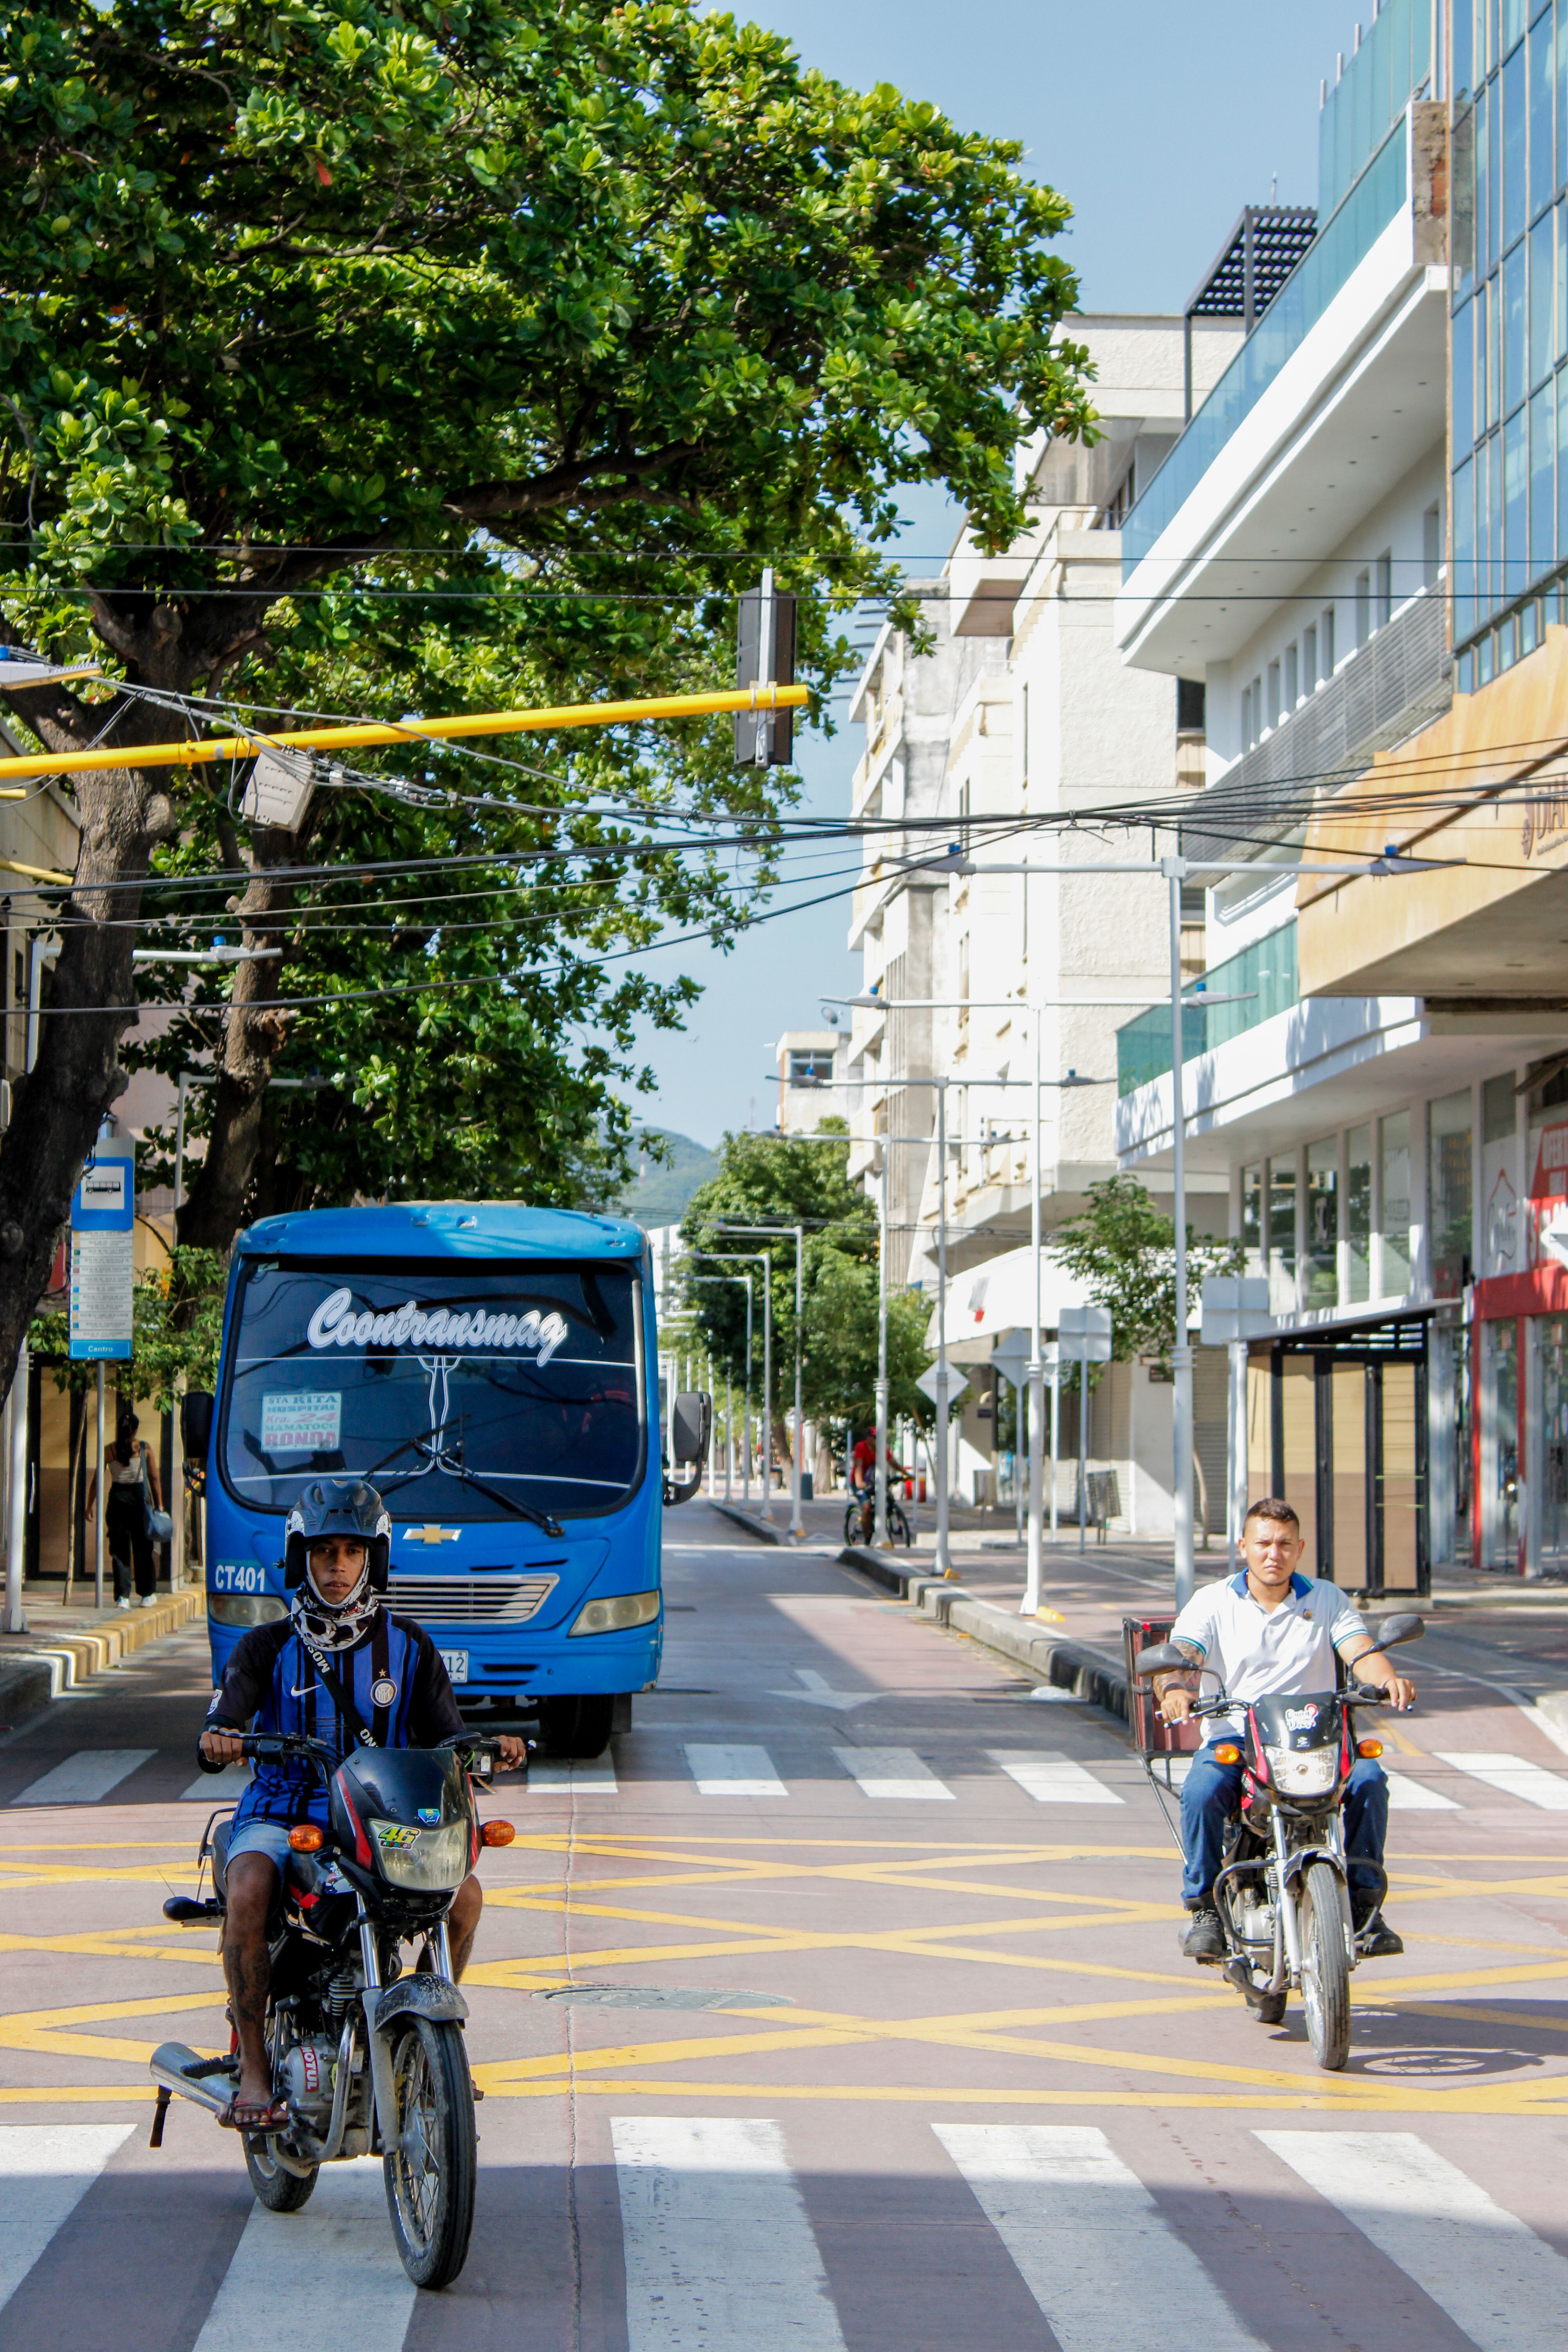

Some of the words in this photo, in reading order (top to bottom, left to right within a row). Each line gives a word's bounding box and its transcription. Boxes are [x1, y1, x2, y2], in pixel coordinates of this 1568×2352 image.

[294, 1412, 336, 1423] 24
[265, 1431, 337, 1446] RONDA
[215, 1564, 265, 1592] CT401
[378, 1825, 419, 1843] 46
[300, 2047, 317, 2090] MOTUL
